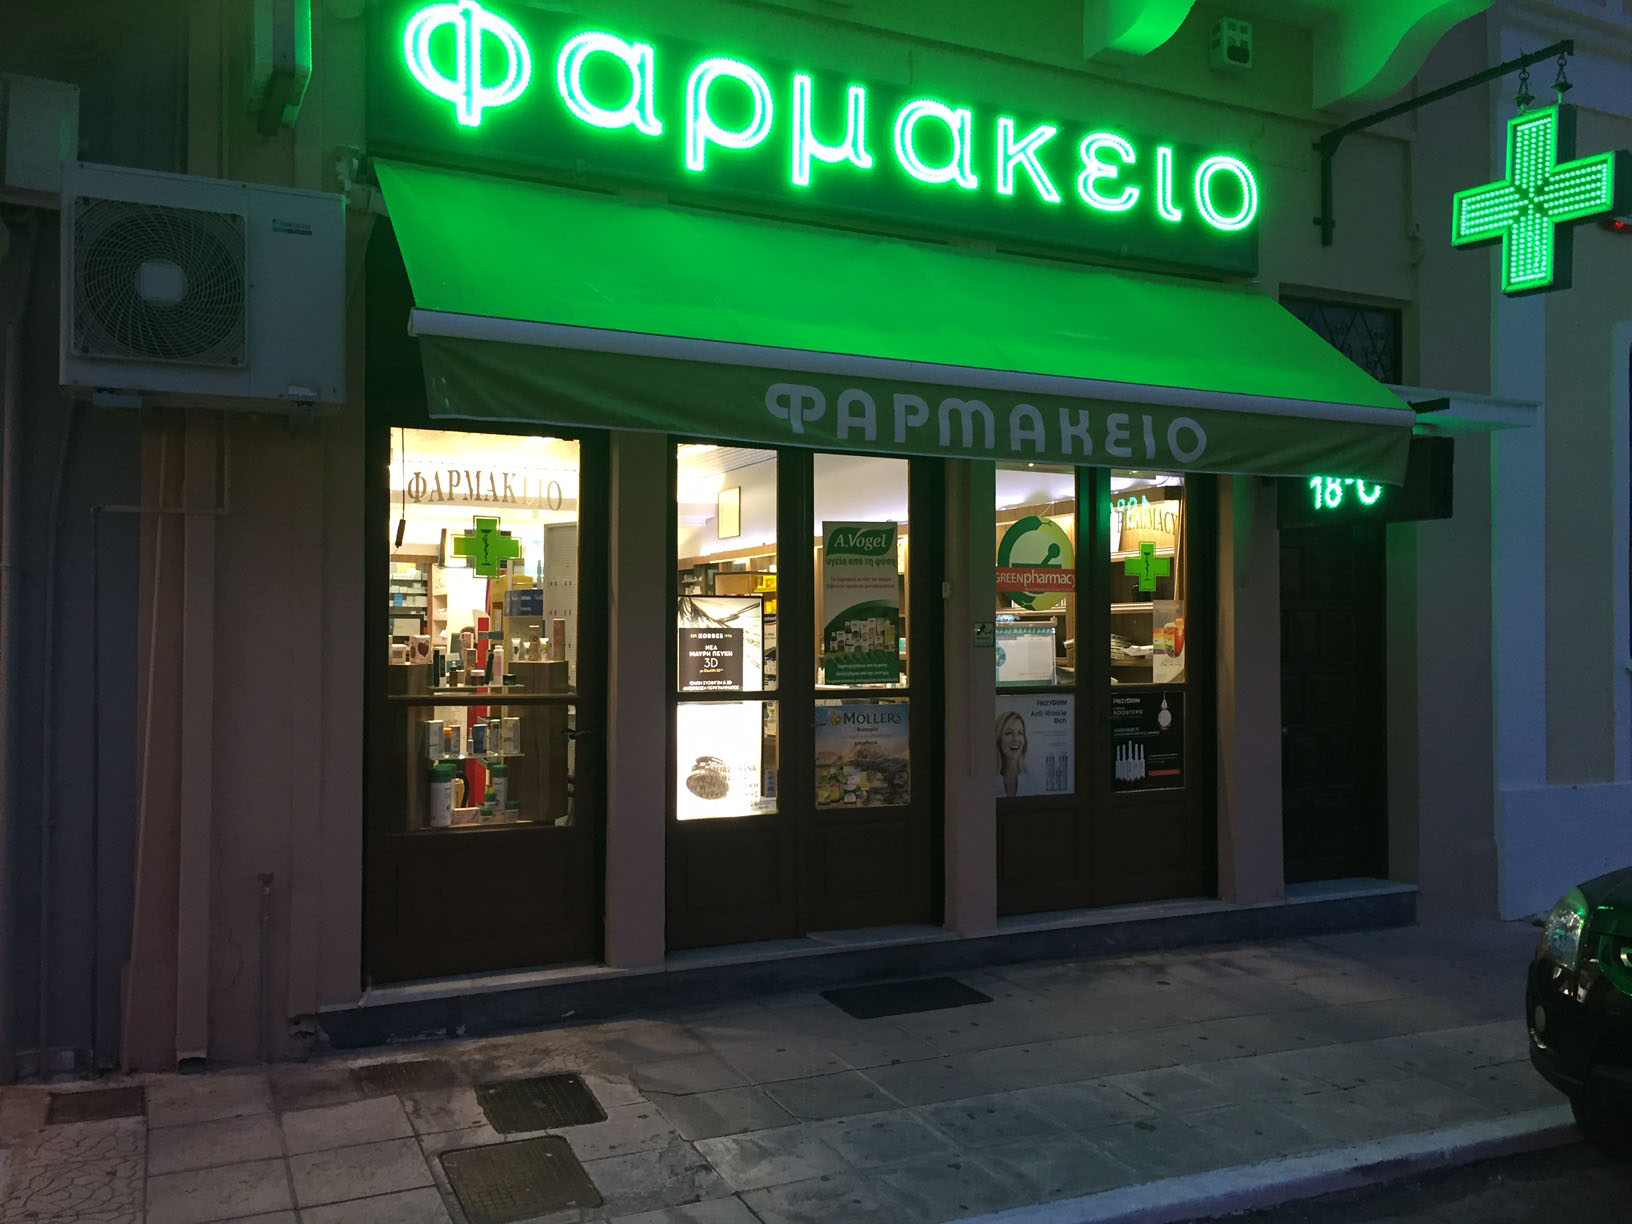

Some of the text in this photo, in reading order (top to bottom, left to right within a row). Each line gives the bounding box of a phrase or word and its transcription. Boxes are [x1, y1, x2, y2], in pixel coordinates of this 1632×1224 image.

[402, 0, 1261, 232] Φαρμακειο
[764, 382, 1208, 464] ΦΑΡΜΑΚΕΙΟ
[834, 533, 887, 551] A.Vogel
[995, 569, 1075, 588] GREENpharmacy
[704, 657, 718, 668] 3D
